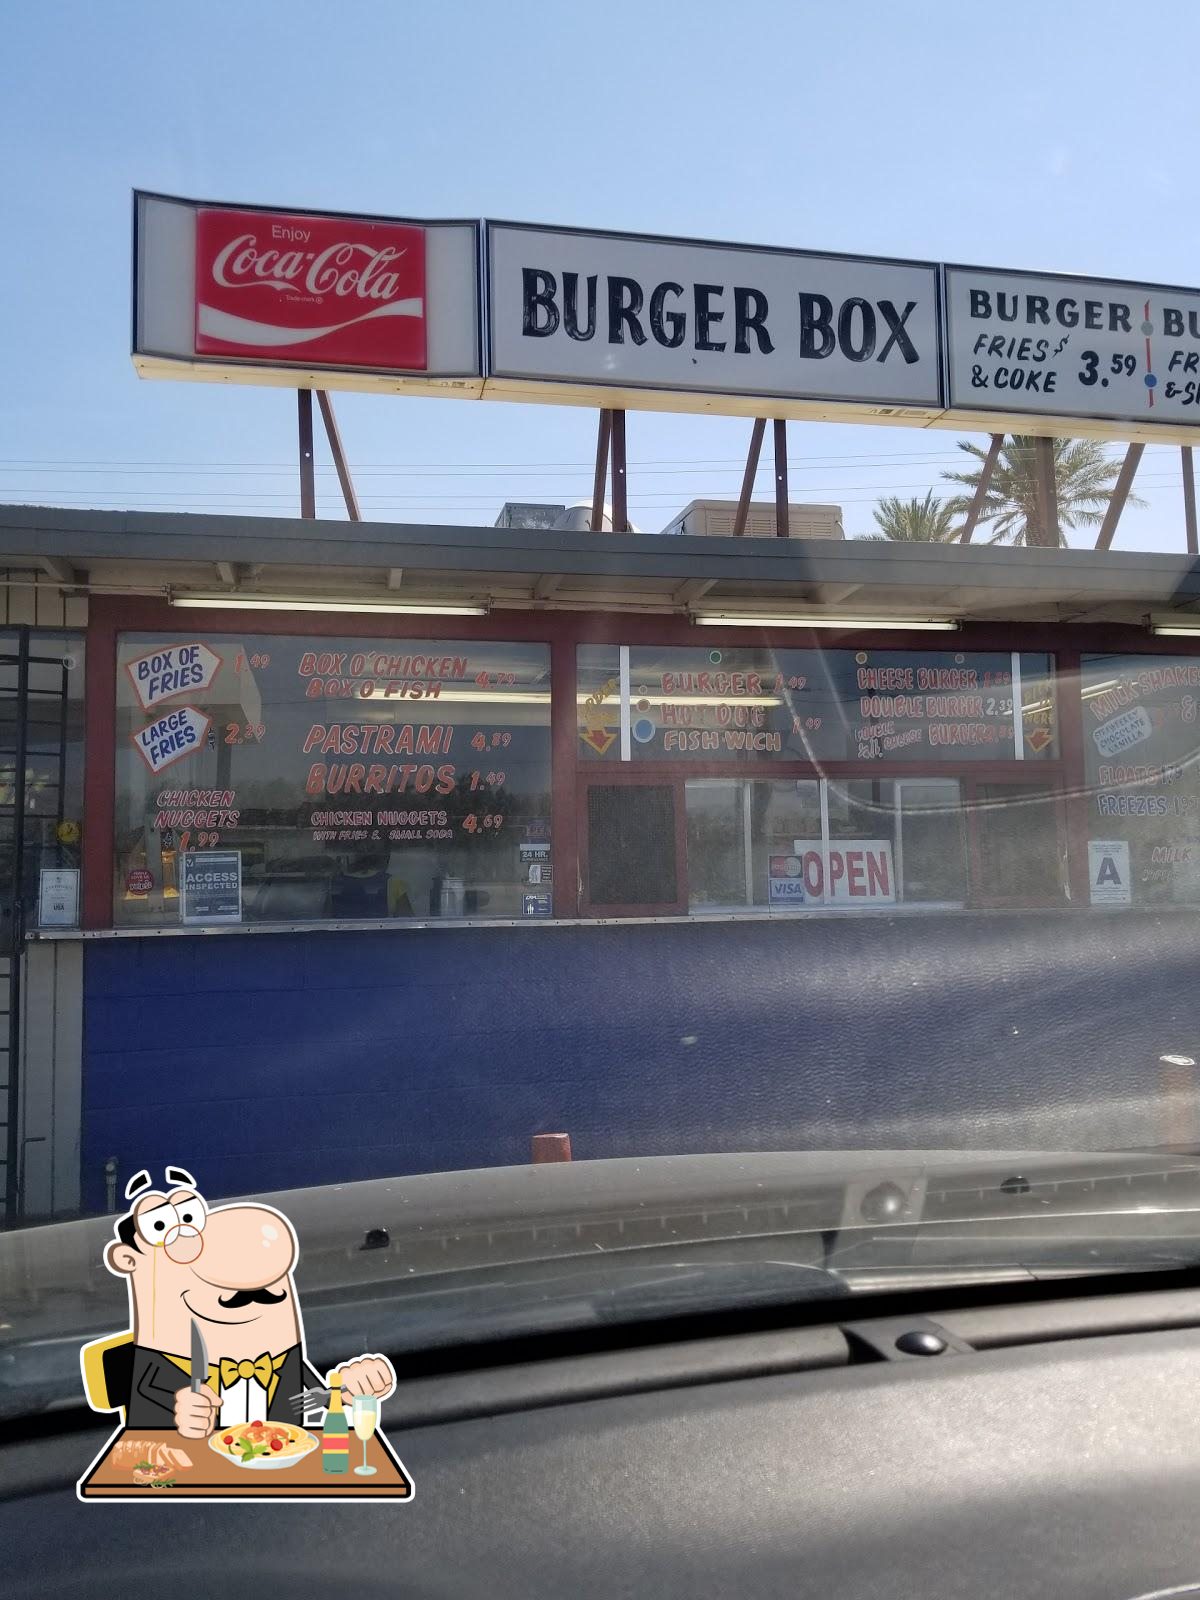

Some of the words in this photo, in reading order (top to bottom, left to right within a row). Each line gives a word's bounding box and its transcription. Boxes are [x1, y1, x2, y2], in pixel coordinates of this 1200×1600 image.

[272, 224, 311, 243] Enjoy
[212, 234, 408, 300] Coca-Cola
[521, 267, 776, 356] BURGER
[798, 292, 920, 365] BOX
[969, 289, 1133, 333] BURGER
[973, 333, 1050, 362] FRIES
[138, 651, 173, 681] BOX
[178, 646, 200, 666] OF
[298, 652, 347, 677] BOX
[148, 663, 204, 700] FRIES
[305, 678, 353, 699] BOX
[383, 680, 442, 700] FISH
[660, 672, 763, 696] BURGER
[857, 667, 914, 690] CHEESE
[917, 667, 978, 690] BURGER
[860, 695, 924, 718] DOUBLE
[926, 695, 984, 718] BURGER
[142, 709, 187, 747] LARGE
[302, 724, 453, 755] PASTRAMI
[150, 726, 196, 765] FRIES
[305, 763, 456, 794] BURRITOS
[156, 790, 236, 807] CHICKEN
[1097, 793, 1169, 817] FREEZES
[154, 810, 241, 829] NUGGETS
[310, 811, 373, 826] CHICKEN
[376, 811, 448, 826] NUGGETS
[186, 872, 238, 882] ACCESS
[803, 851, 890, 898] OPEN
[1095, 856, 1122, 886] A
[185, 882, 238, 891] INSPECTED
[774, 883, 803, 895] VISA
